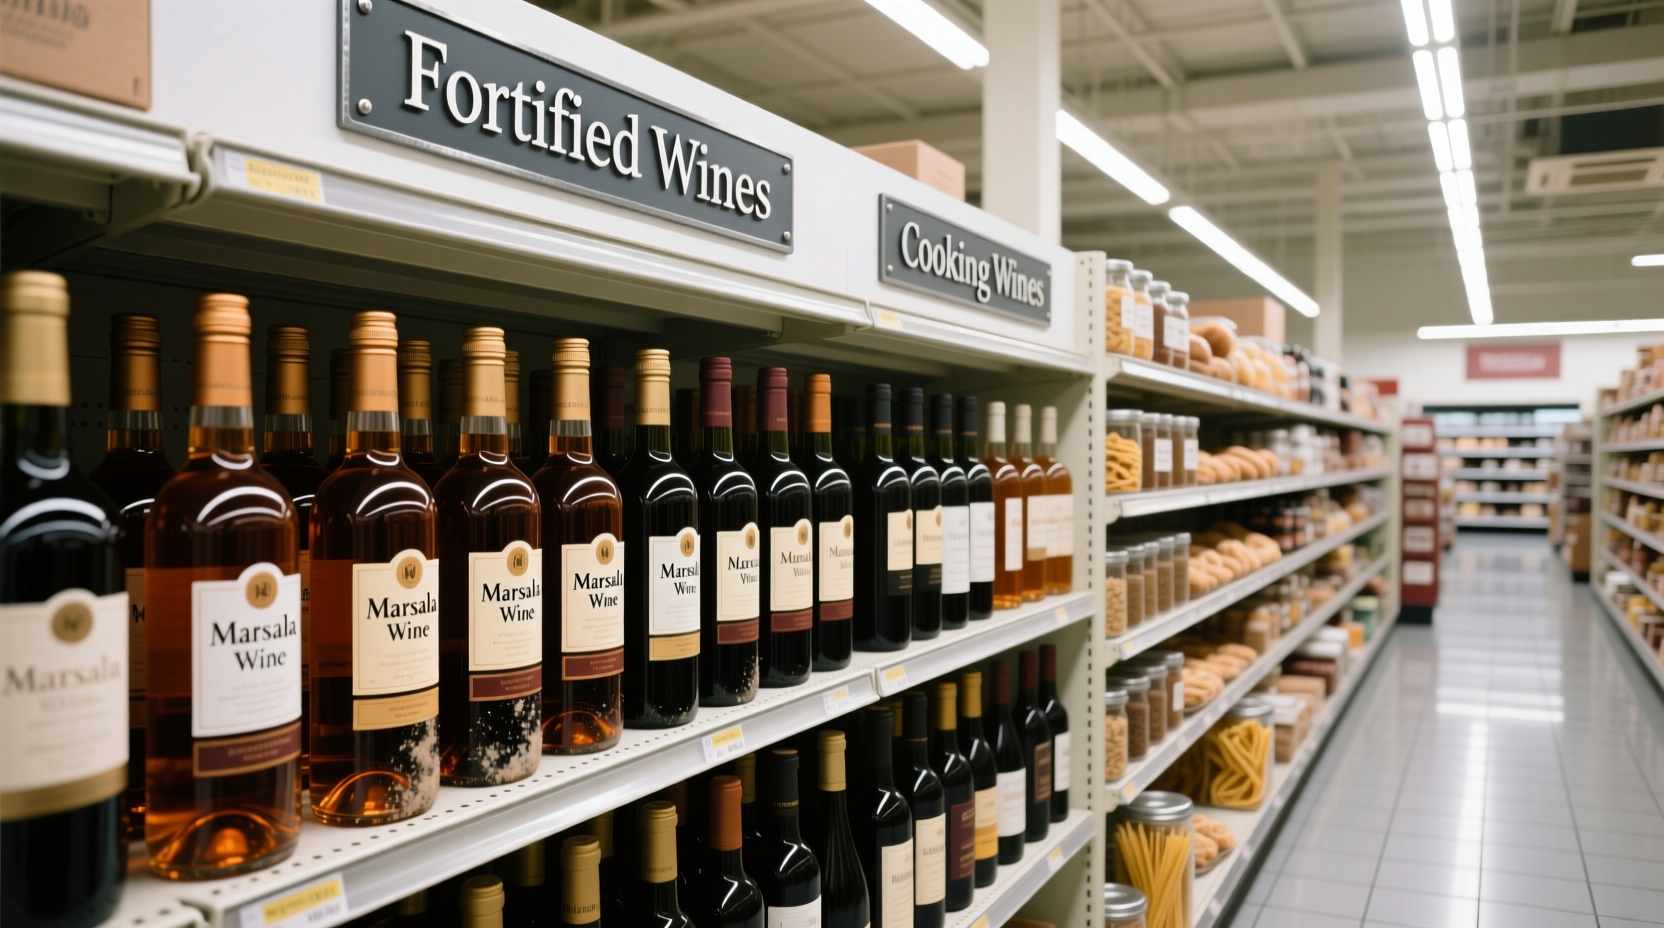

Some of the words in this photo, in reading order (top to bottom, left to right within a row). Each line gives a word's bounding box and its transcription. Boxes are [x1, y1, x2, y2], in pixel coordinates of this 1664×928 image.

[403, 29, 643, 178] Fortified
[650, 125, 772, 220] Wines
[901, 221, 992, 304] Cooking
[991, 252, 1045, 308] Wines
[660, 560, 699, 579] Marl
[481, 578, 541, 602] Marsala
[588, 592, 618, 609] Wine
[366, 591, 437, 620] Marsala
[499, 604, 535, 623] Wine
[209, 613, 297, 647] Marsala
[386, 621, 430, 642] Wine
[234, 648, 287, 672] Wine
[3, 653, 121, 697] Marsala
